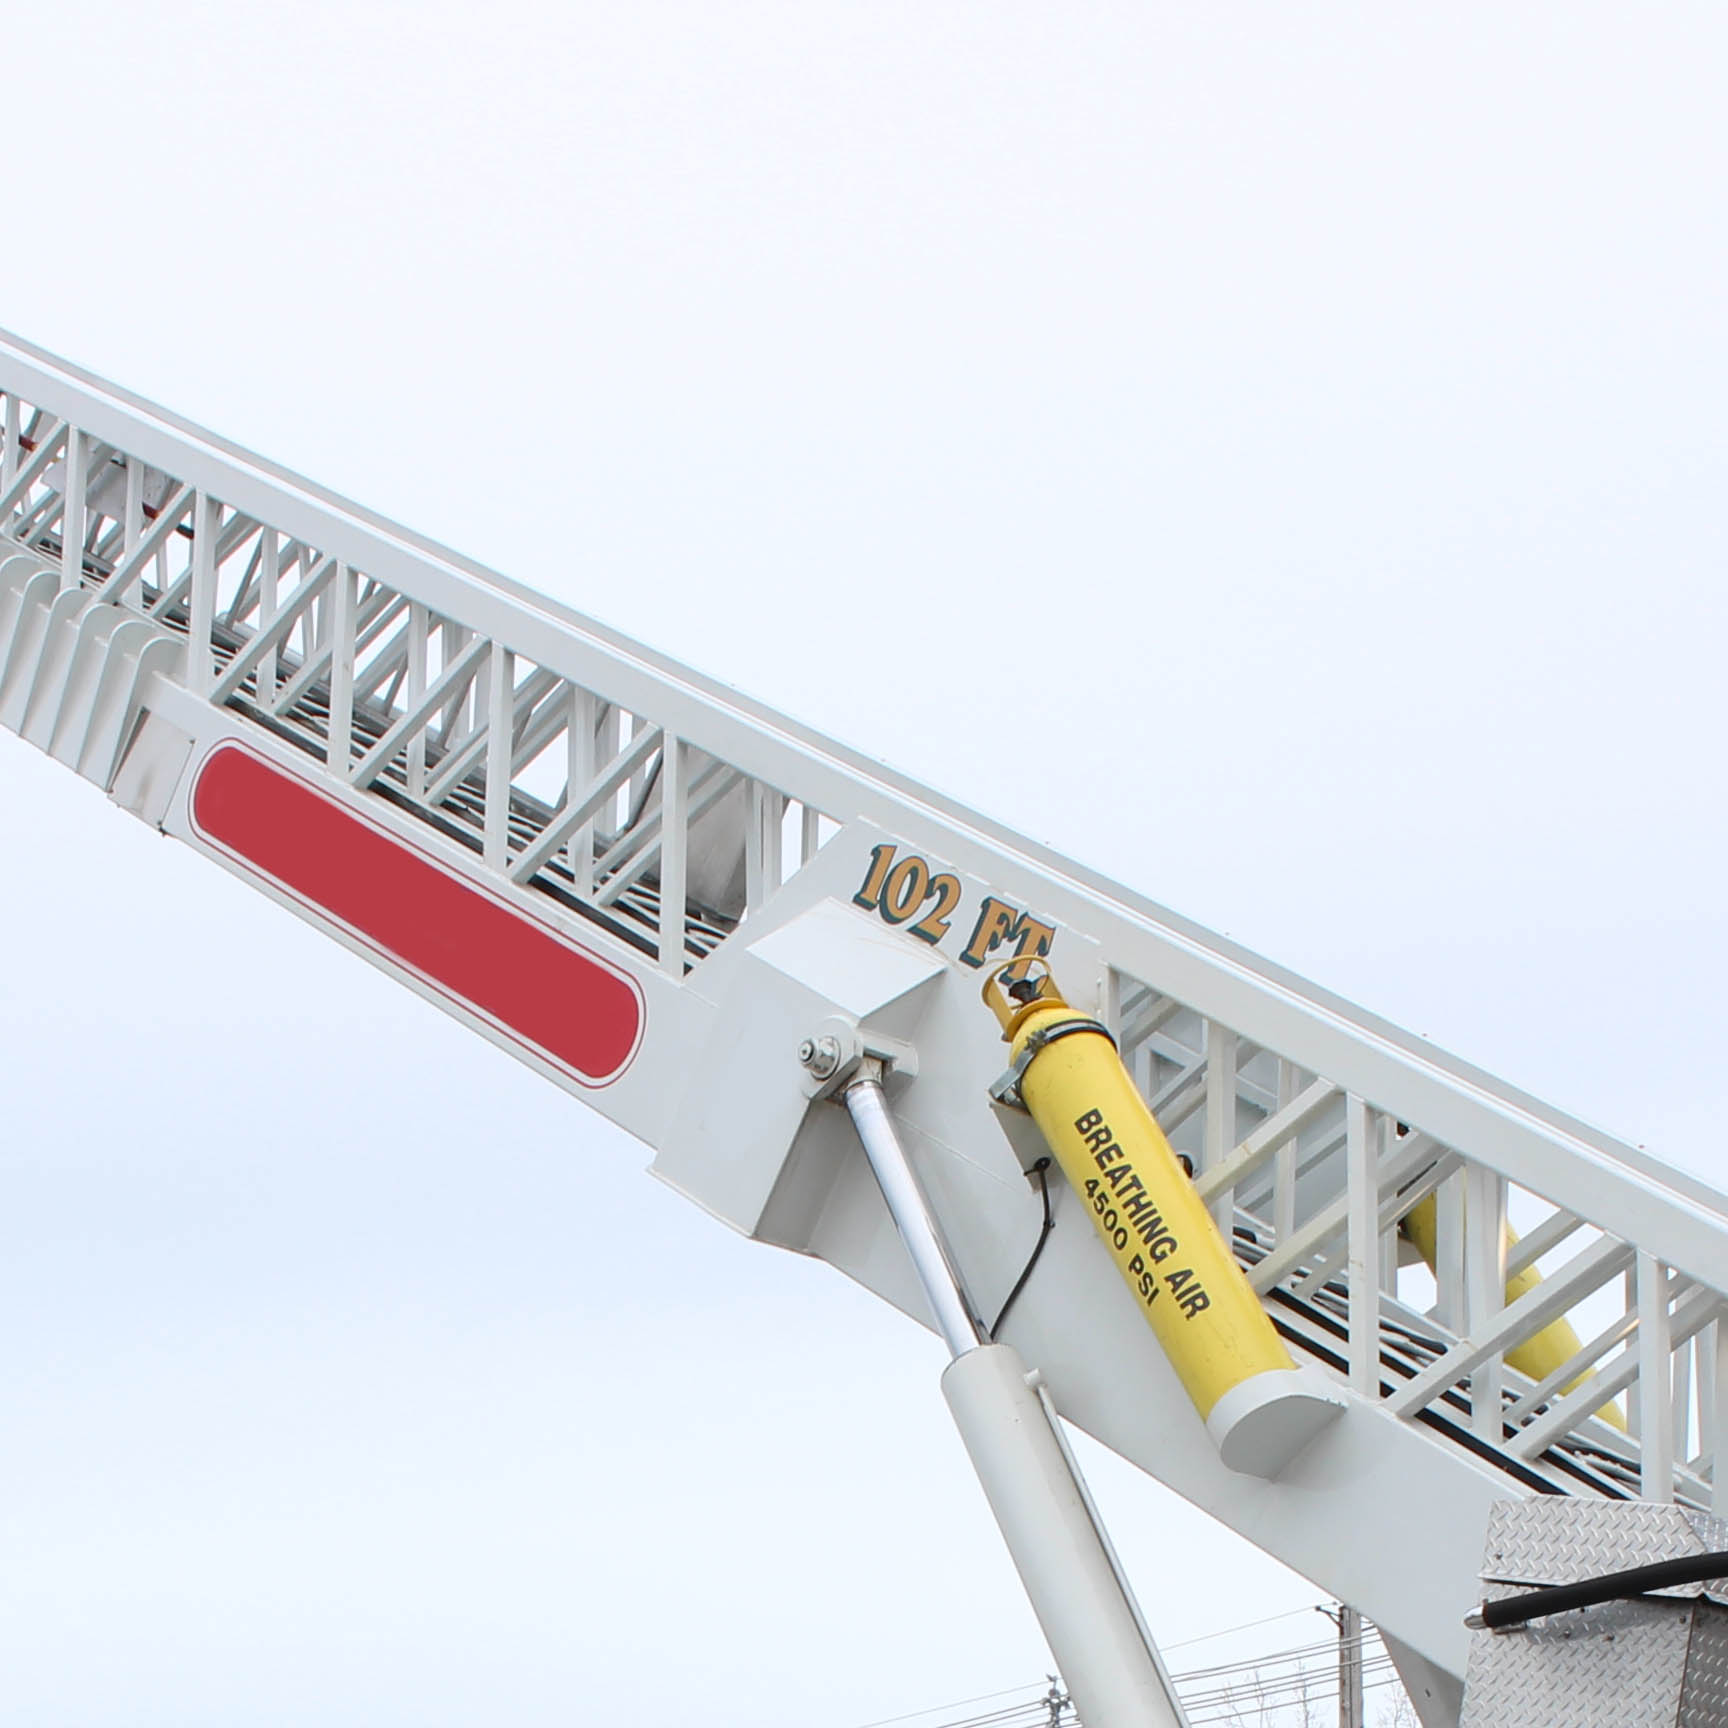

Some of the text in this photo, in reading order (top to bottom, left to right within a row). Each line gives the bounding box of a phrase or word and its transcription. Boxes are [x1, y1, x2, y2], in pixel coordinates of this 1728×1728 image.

[852, 844, 1056, 998] 102 FT
[1074, 1108, 1211, 1321] BREATHING AIR
[1084, 1178, 1160, 1307] 4500 PSI
